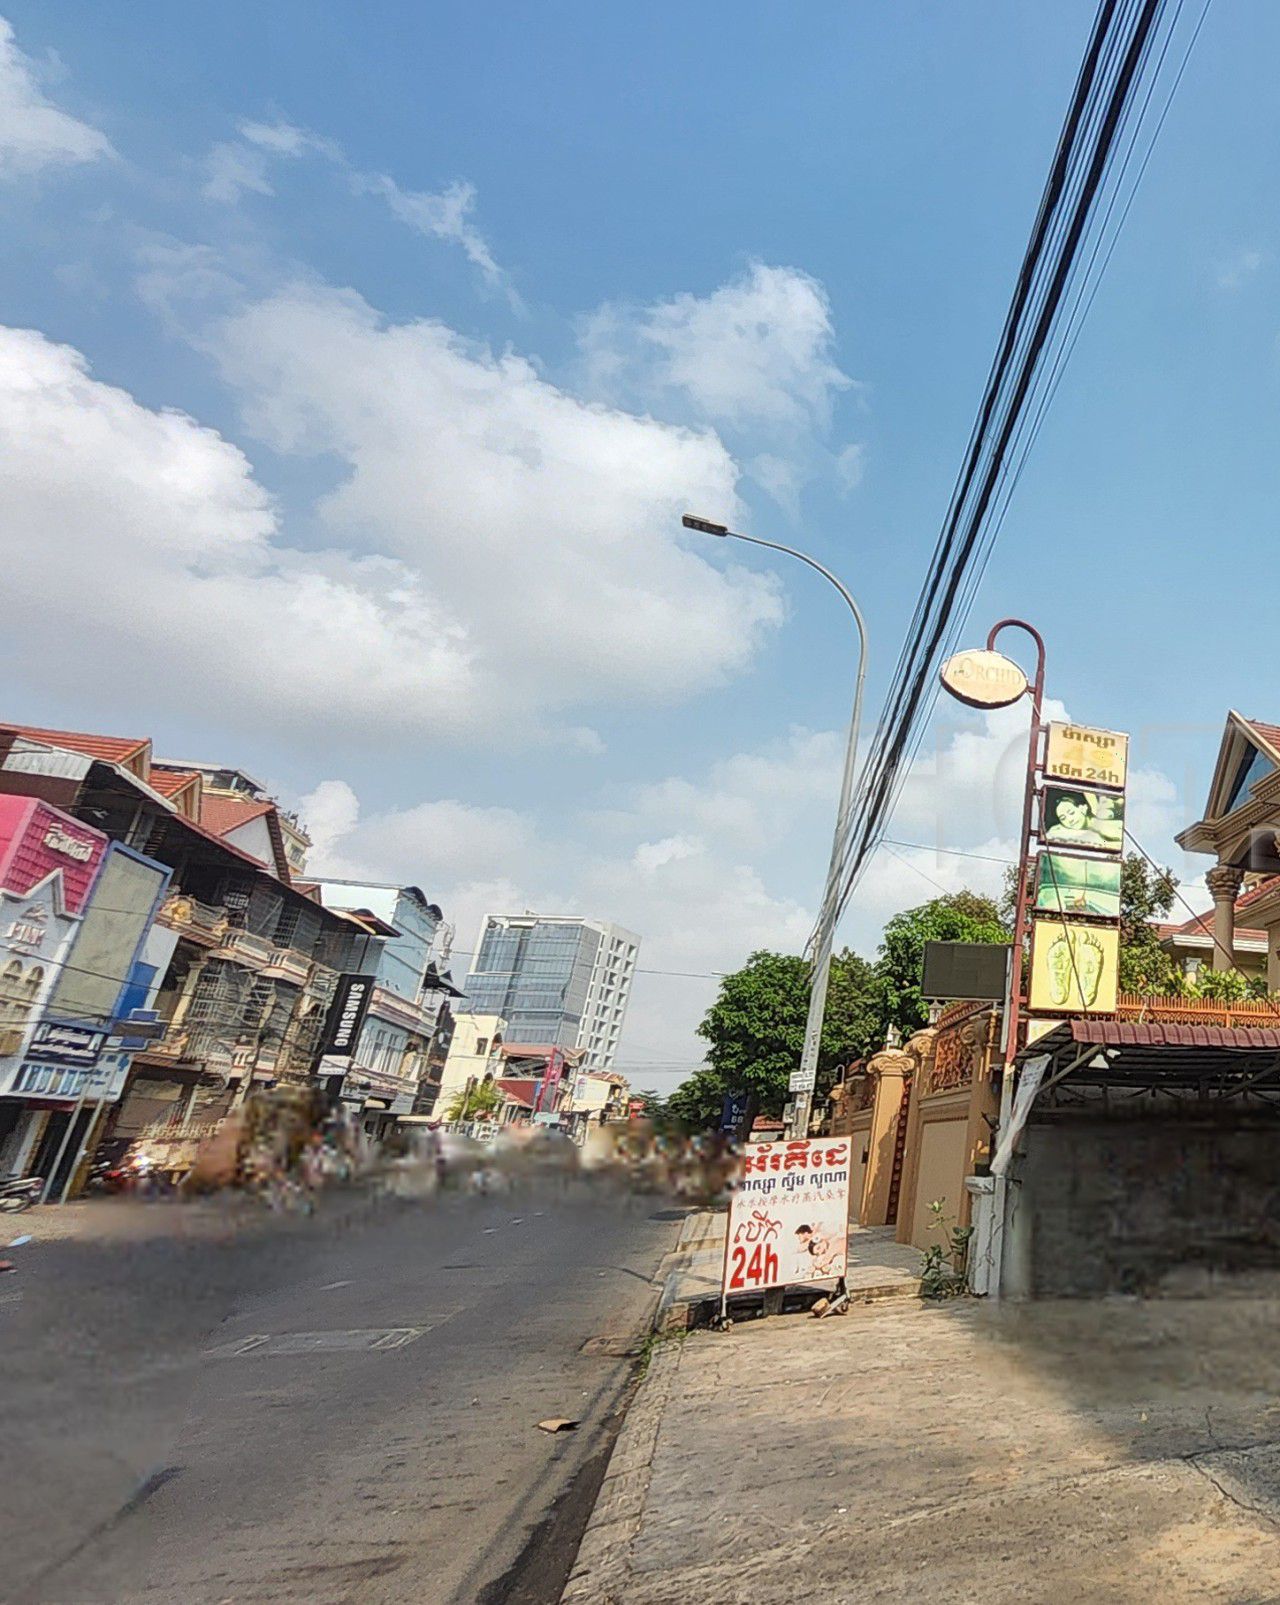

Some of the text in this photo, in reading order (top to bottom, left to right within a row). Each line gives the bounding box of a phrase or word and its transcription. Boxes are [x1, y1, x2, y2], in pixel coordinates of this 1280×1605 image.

[1086, 767, 1119, 784] 24h
[334, 983, 366, 1047] SAMSUNG
[729, 1243, 779, 1290] 24h
